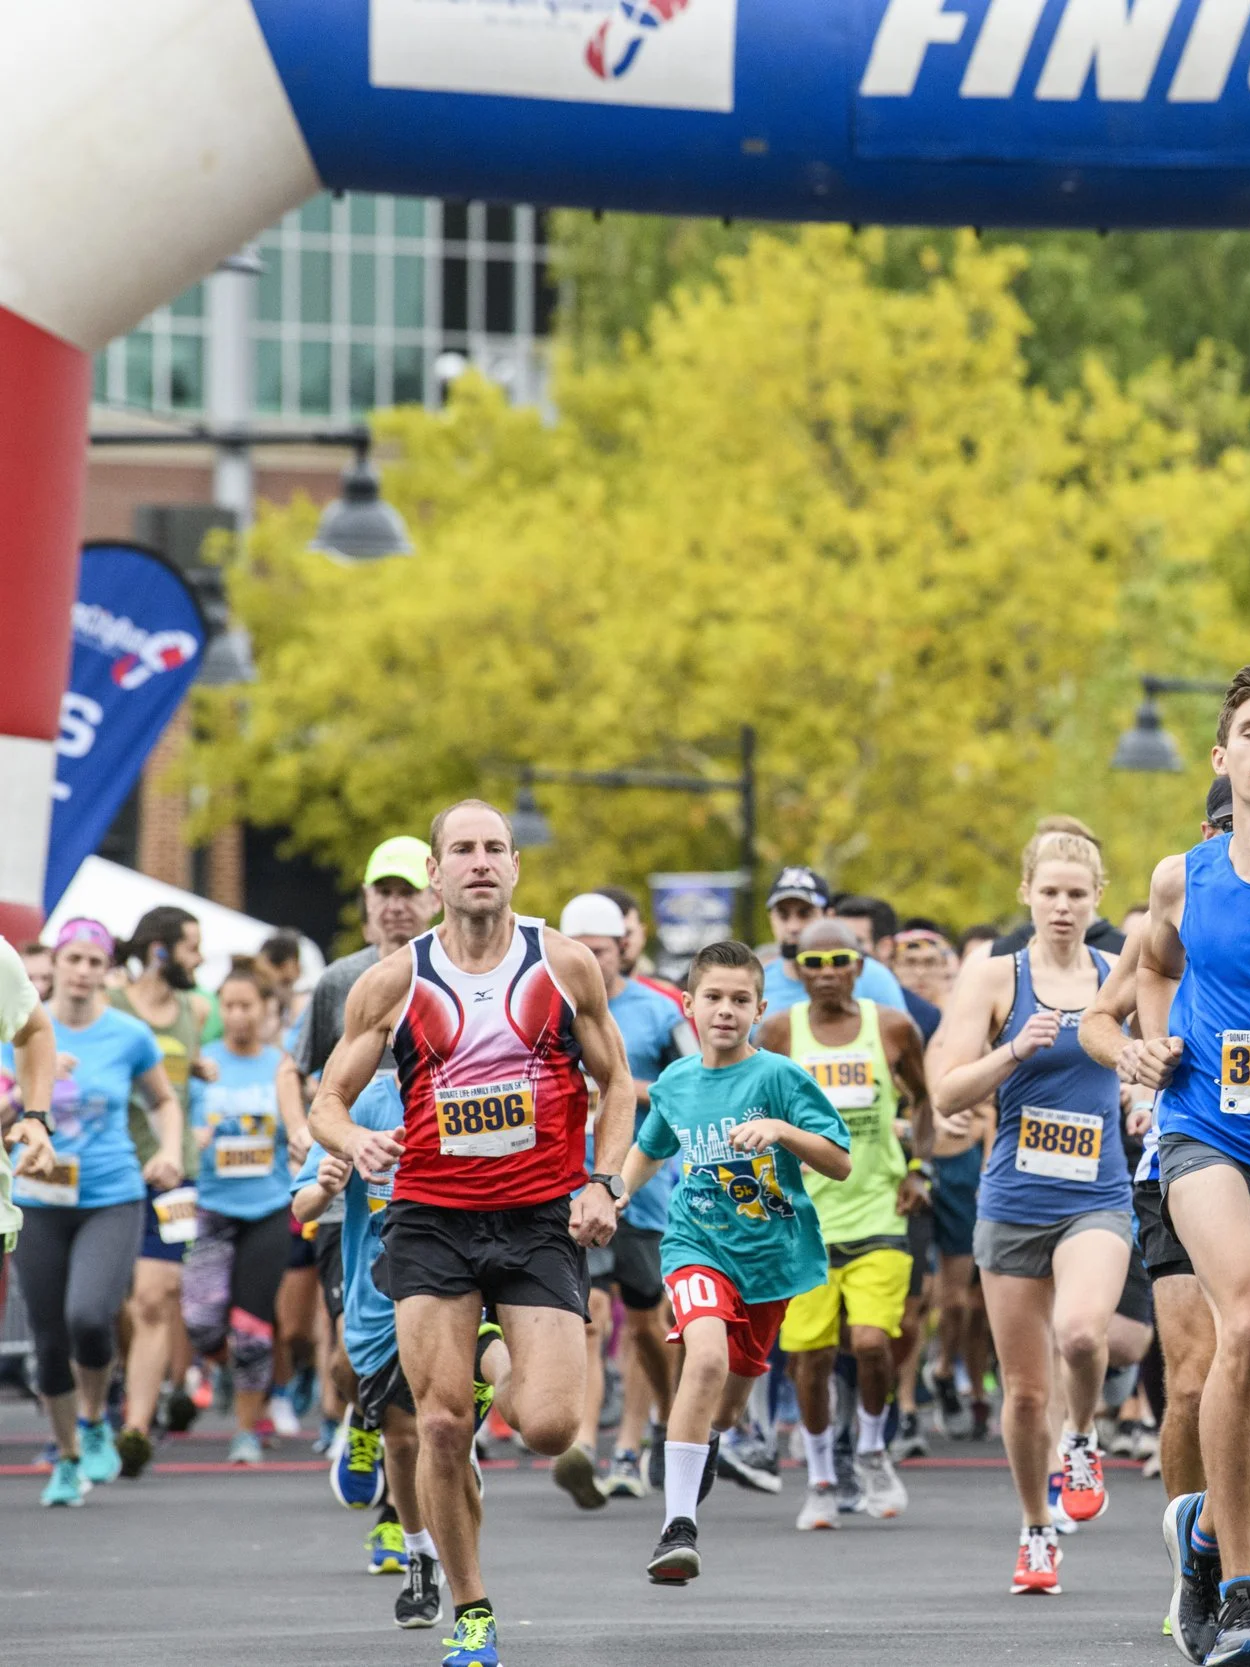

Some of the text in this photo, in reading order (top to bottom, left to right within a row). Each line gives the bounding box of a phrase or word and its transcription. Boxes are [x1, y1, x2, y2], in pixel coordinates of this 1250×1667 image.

[443, 1094, 525, 1135] 3896
[1025, 1120, 1095, 1157] 3898
[674, 1272, 718, 1316] 10
